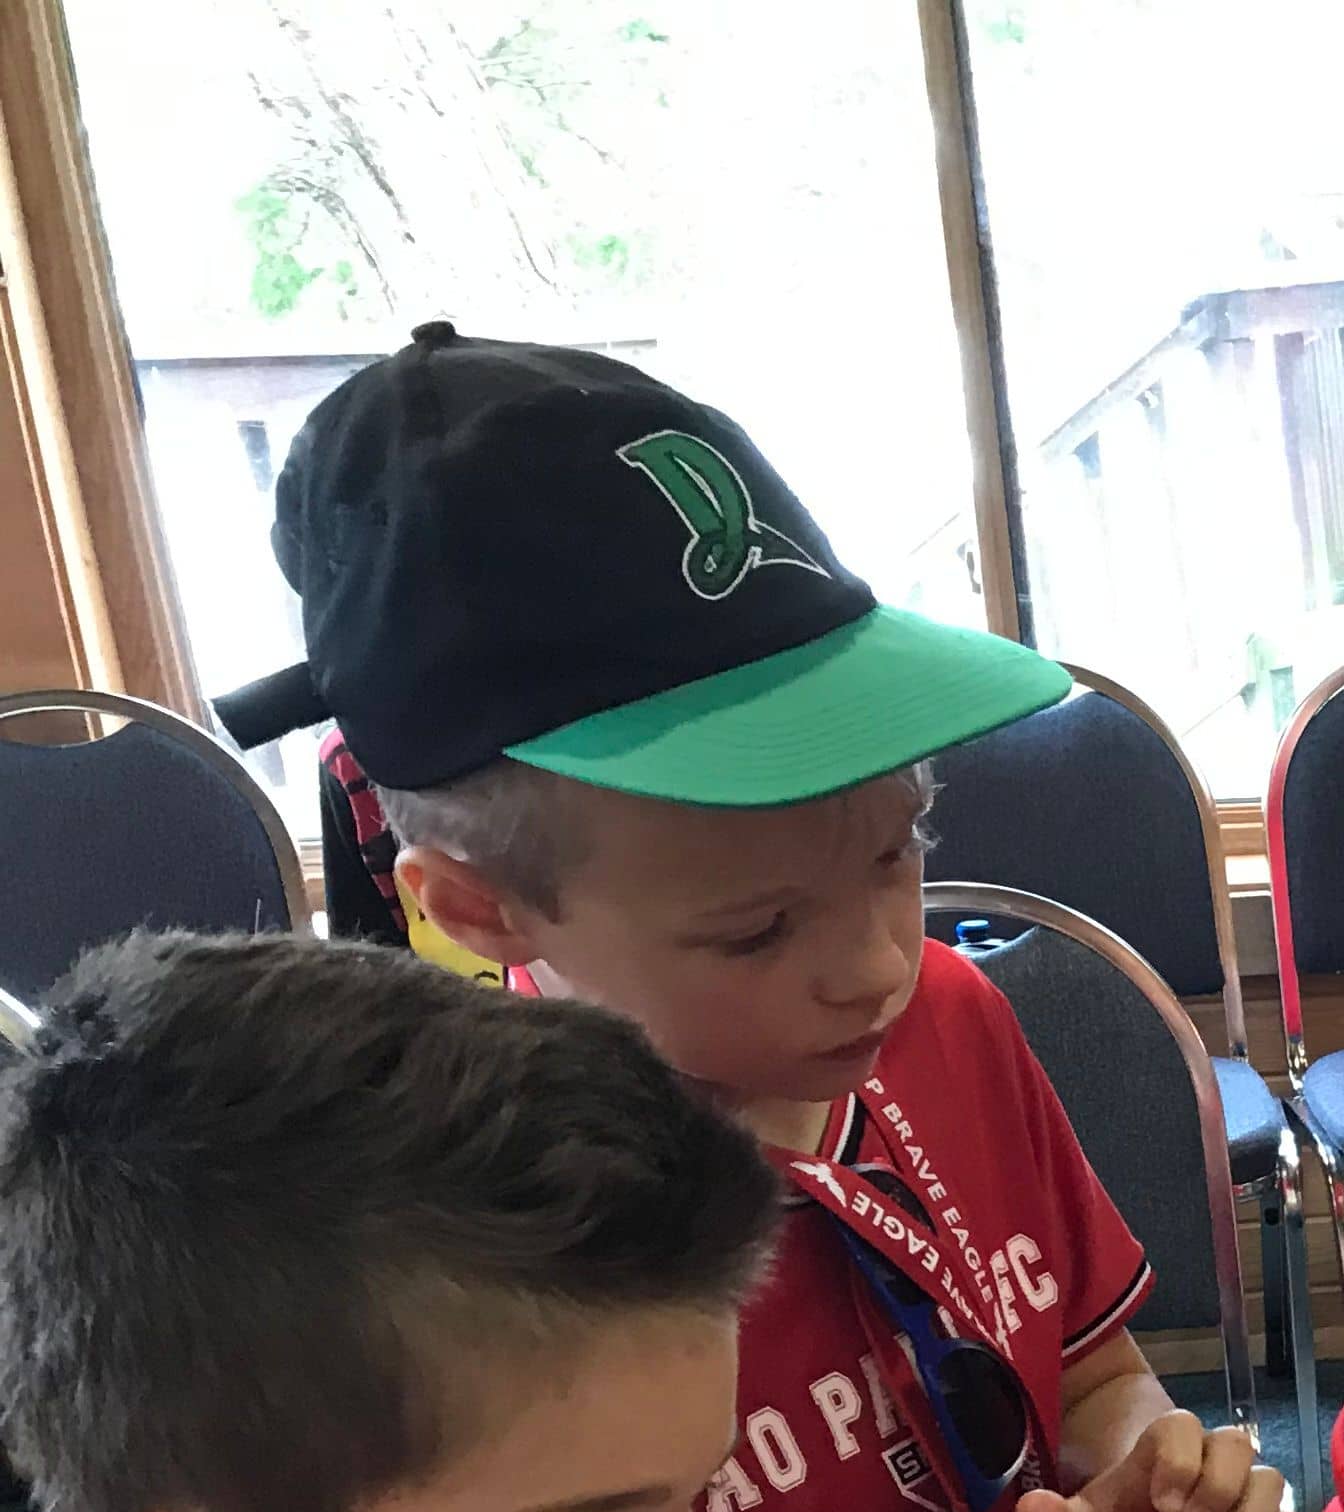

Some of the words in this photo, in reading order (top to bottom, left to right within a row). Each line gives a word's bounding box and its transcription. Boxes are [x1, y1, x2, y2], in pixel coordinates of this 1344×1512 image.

[851, 1190, 941, 1273] EAGLE
[881, 1102, 948, 1202] BRAVE
[942, 1206, 994, 1303] EAGLE
